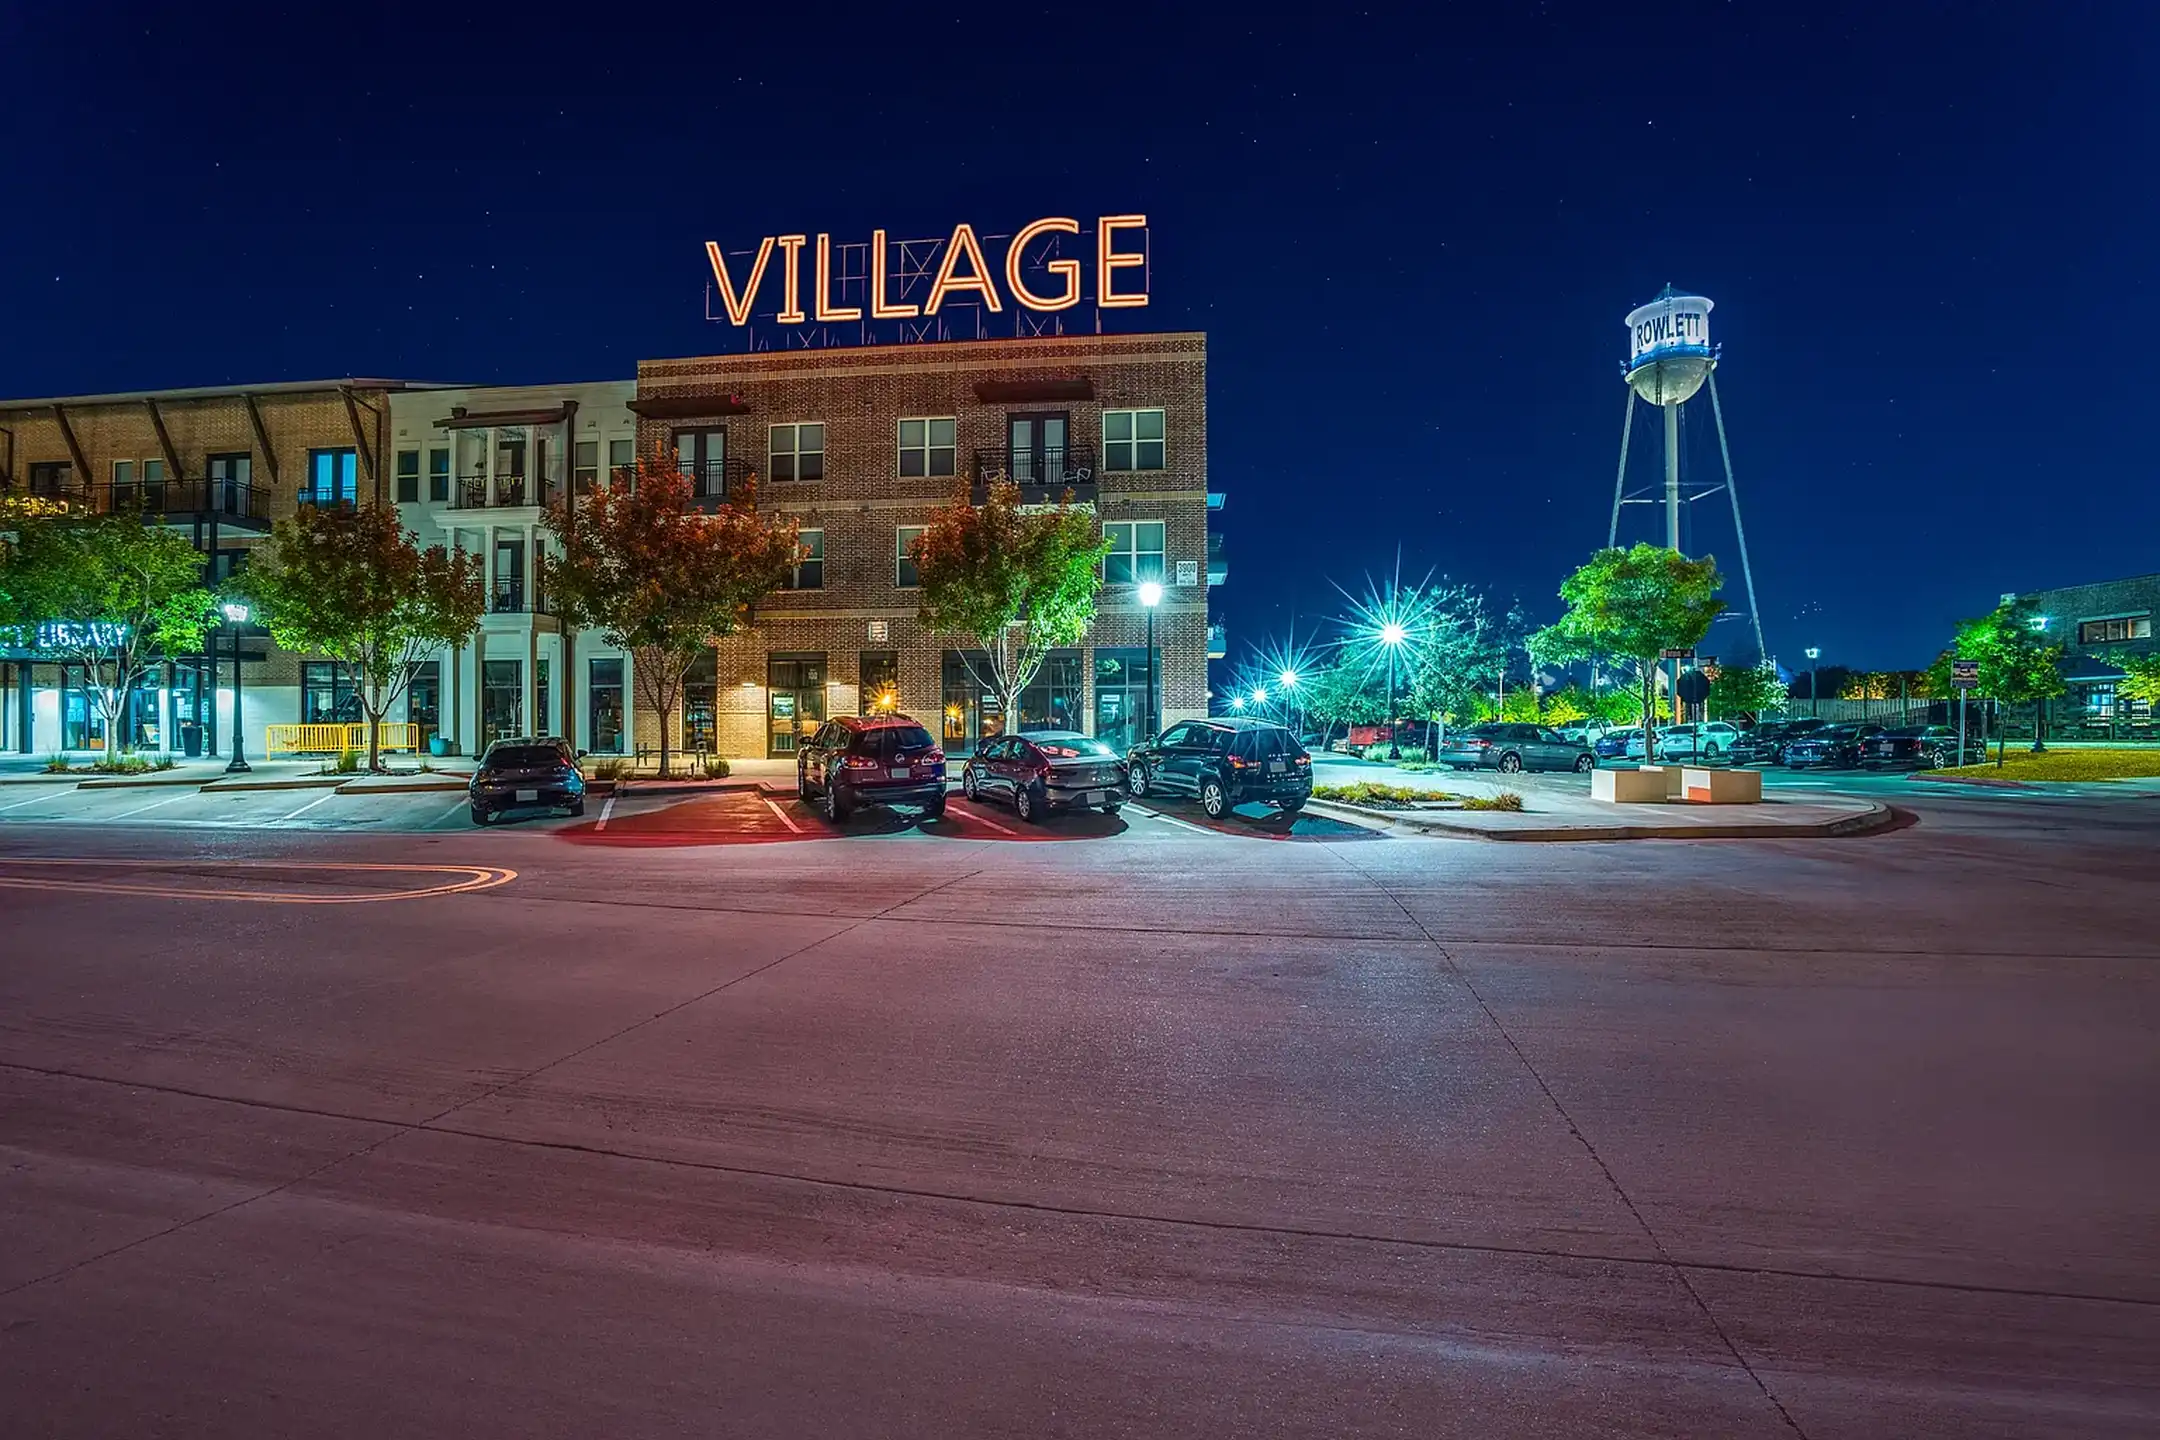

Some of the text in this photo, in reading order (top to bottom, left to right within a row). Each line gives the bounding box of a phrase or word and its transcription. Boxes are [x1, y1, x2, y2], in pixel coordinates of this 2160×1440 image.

[705, 214, 1149, 326] VILLAGE
[1636, 313, 1701, 349] ROWLETT
[39, 623, 126, 648] LIBRARY
